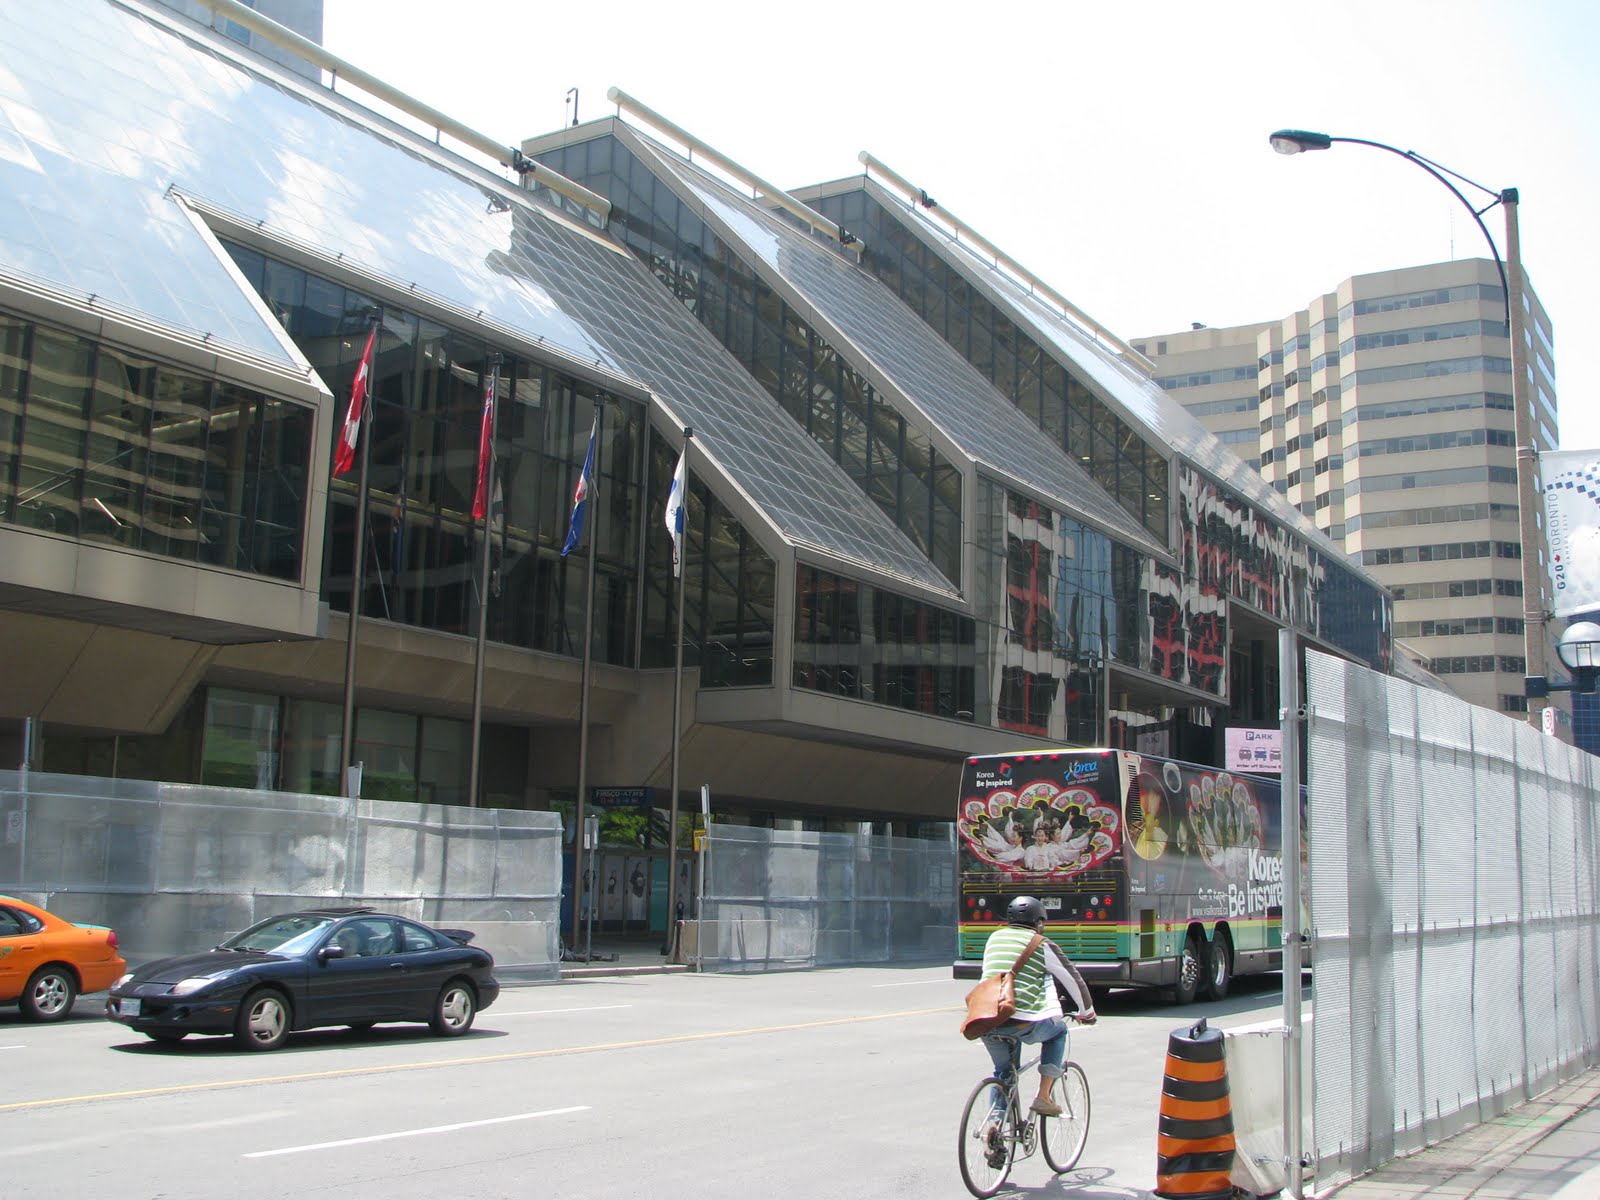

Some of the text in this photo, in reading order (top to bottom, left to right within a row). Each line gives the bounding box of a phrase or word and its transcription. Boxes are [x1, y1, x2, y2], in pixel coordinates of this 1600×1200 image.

[1548, 493, 1566, 590] G20 TORONTO
[1245, 731, 1273, 741] PARK
[976, 771, 995, 779] Korea
[1063, 760, 1098, 780] Korea
[976, 778, 1013, 789] Be Inspired
[1228, 883, 1246, 918] Be
[1247, 880, 1282, 918] Inspire
